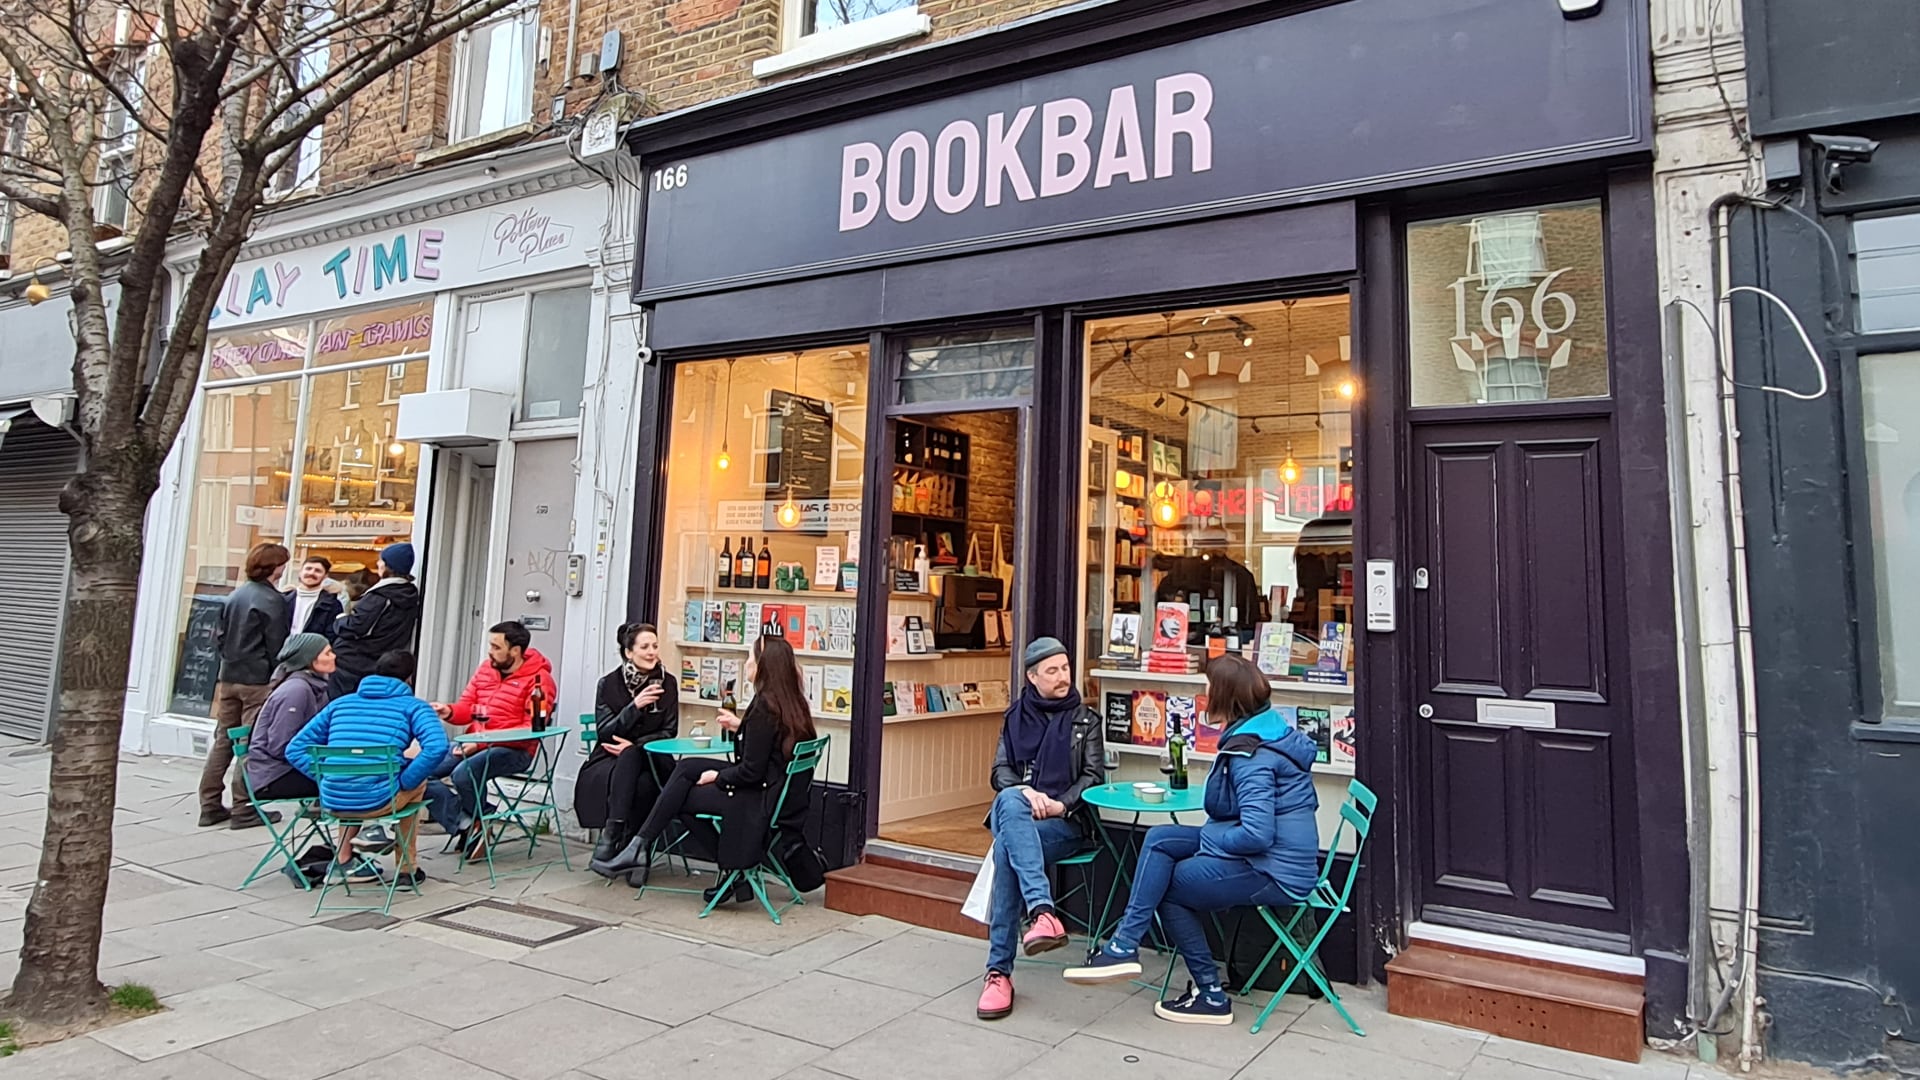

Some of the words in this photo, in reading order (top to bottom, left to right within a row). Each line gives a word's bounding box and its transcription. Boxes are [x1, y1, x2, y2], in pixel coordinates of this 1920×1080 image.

[653, 163, 688, 192] 166
[839, 72, 1213, 232] BOOKBAR
[211, 261, 301, 319] LAY
[323, 229, 444, 298] TIME
[1446, 266, 1577, 340] 166
[360, 315, 431, 348] CERAMICS
